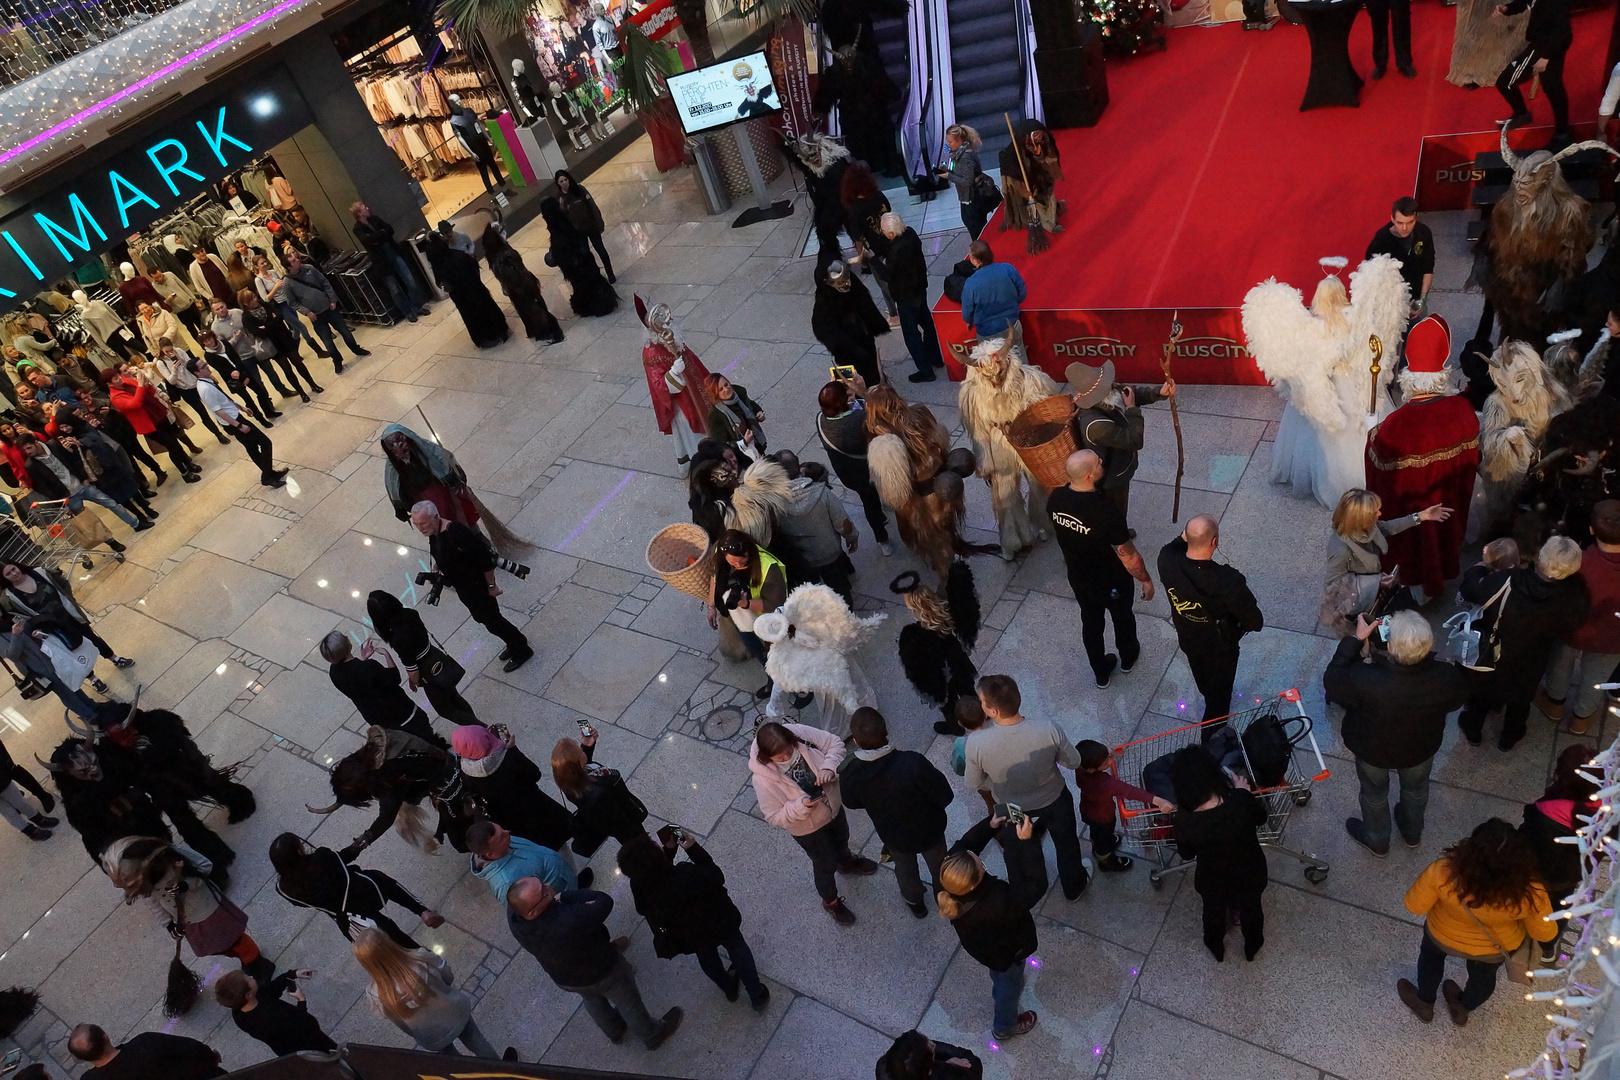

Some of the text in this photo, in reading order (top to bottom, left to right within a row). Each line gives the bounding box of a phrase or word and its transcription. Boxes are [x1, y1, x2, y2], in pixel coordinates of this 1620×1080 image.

[794, 44, 802, 71] PLUSCITY
[681, 79, 730, 99] PERCHTEN-
[790, 74, 800, 103] photos
[684, 94, 707, 108] LAUF
[1435, 169, 1486, 183] PLUS
[0, 106, 253, 298] IMARK
[1052, 343, 1137, 358] PLUSCITY
[1162, 343, 1250, 359] PLUSCITY
[1052, 512, 1091, 535] PLUSCITY
